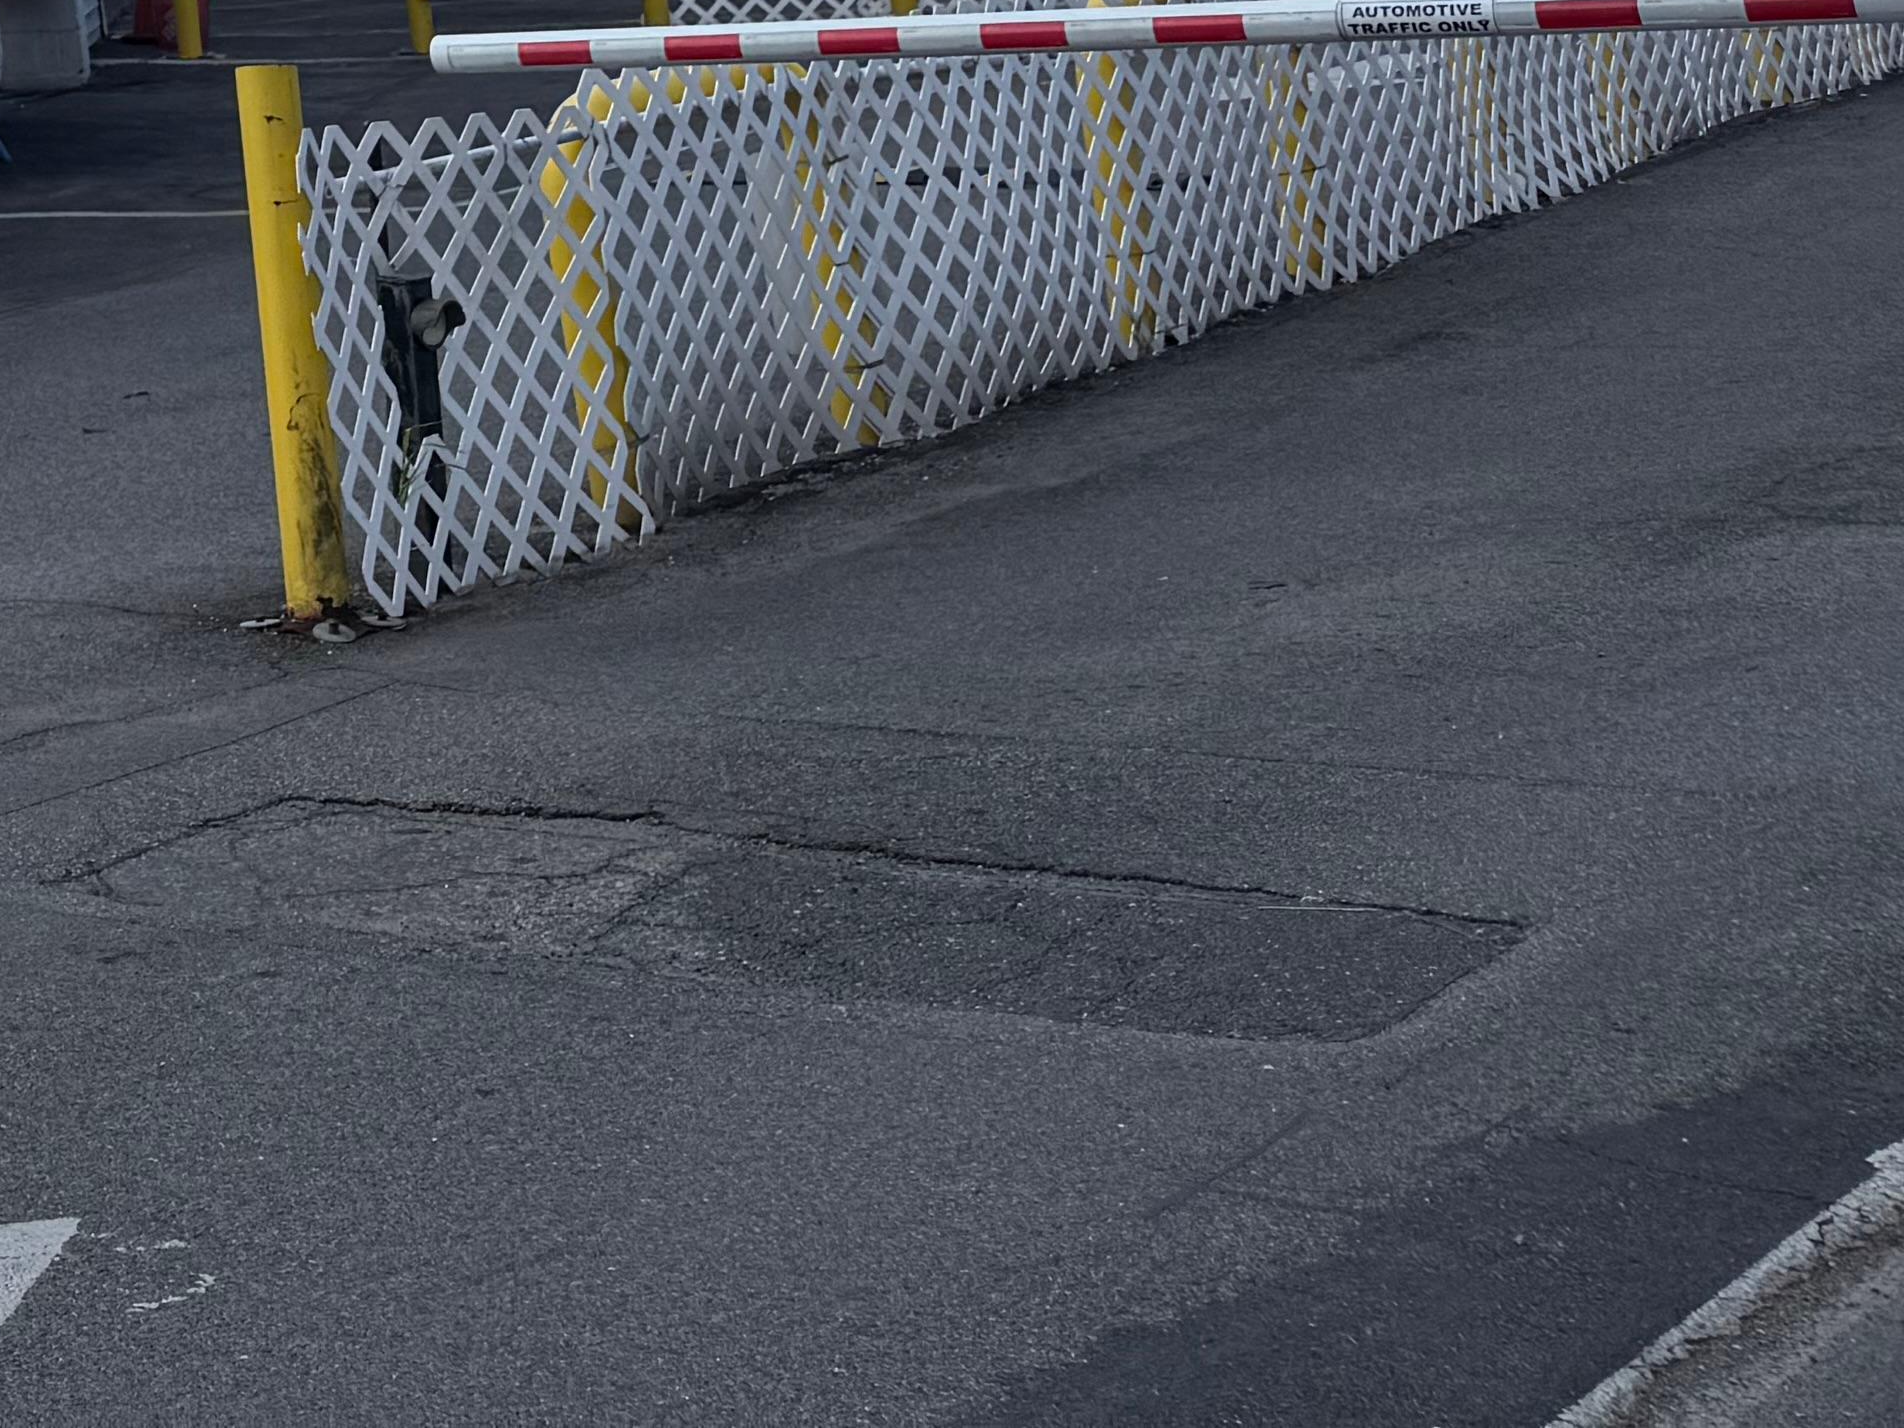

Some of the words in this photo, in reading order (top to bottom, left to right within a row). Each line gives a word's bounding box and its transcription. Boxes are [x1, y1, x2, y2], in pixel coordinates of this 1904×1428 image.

[1352, 3, 1483, 18] AUTOMOTIVE
[1347, 21, 1433, 35] TRAFFIC
[1438, 19, 1490, 33] ONLY
